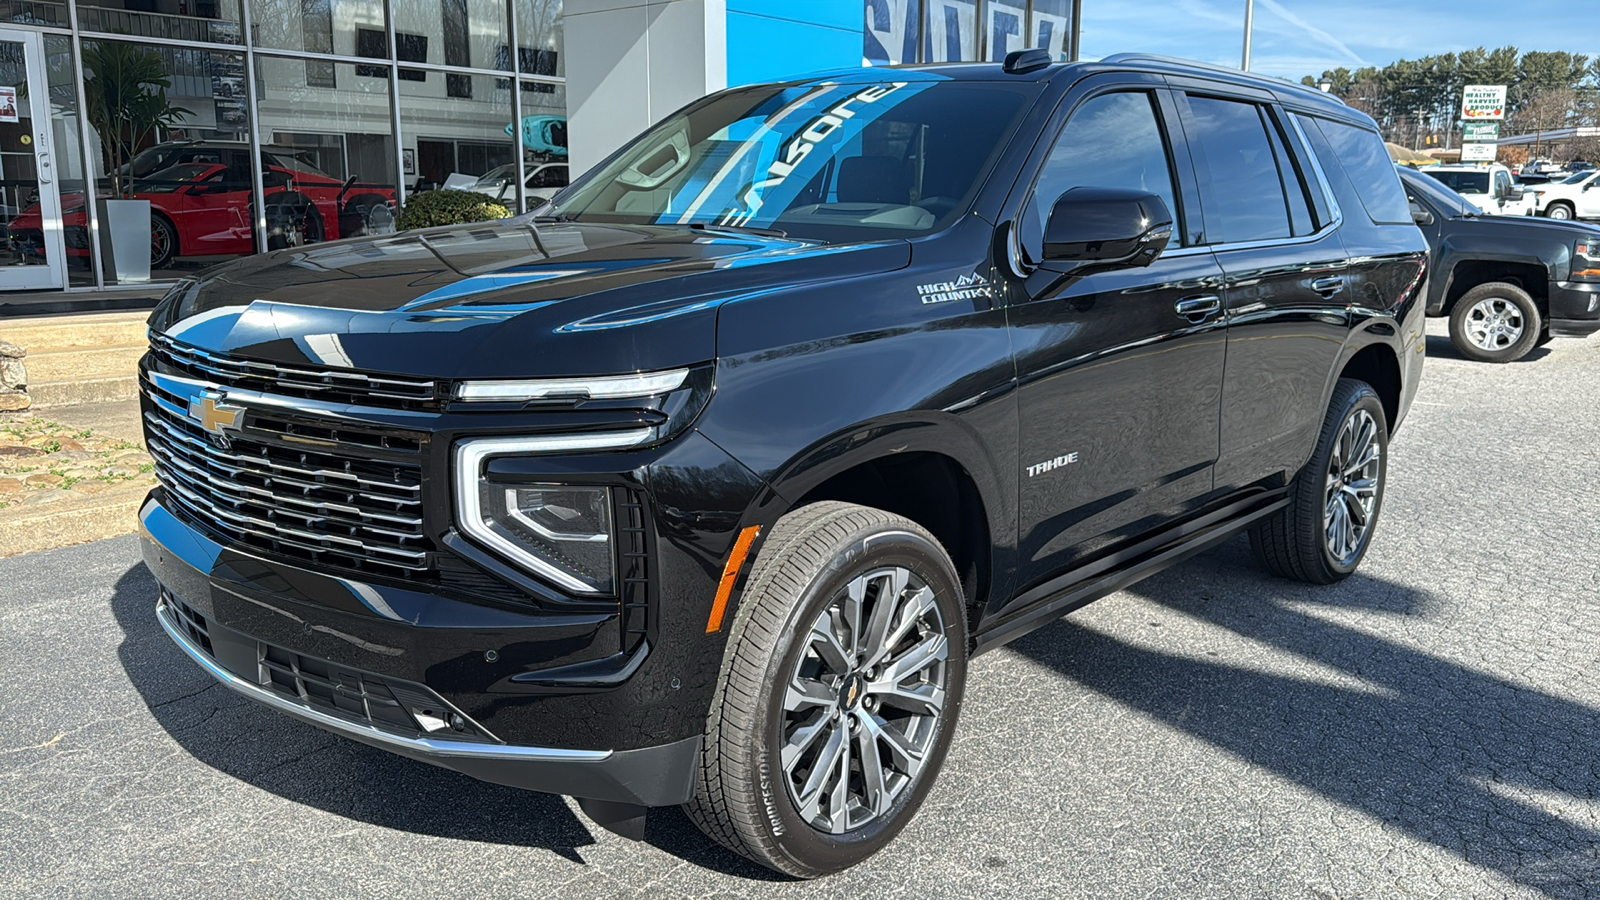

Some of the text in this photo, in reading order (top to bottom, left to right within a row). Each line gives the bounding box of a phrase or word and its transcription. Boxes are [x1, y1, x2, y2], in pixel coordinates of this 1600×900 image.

[916, 281, 958, 295] HIGH
[921, 287, 992, 304] COUNTRY
[1026, 451, 1079, 478] TAHOE
